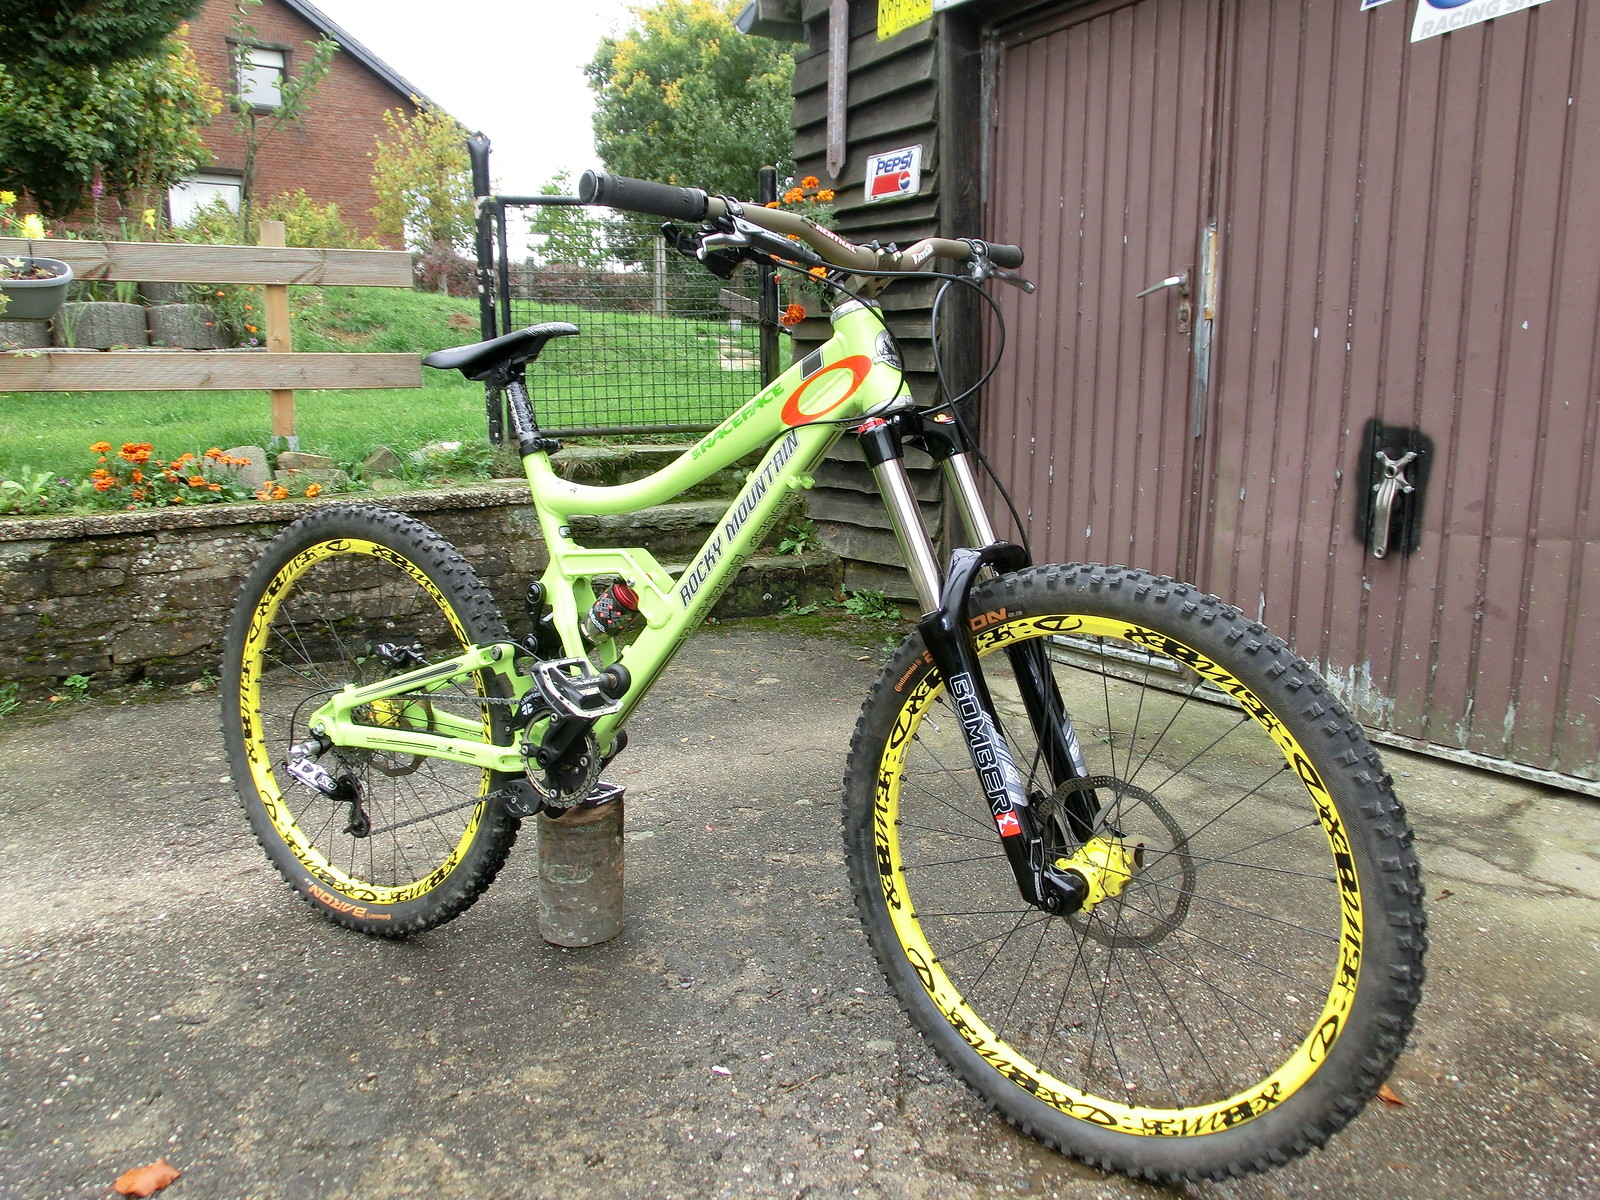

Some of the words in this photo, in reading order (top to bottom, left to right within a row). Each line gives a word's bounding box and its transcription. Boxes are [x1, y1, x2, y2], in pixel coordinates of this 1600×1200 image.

[1419, 2, 1501, 39] RACING
[875, 152, 913, 175] PEPSI
[815, 224, 858, 254] RENTHAL
[678, 535, 723, 609] ROCKY
[724, 429, 799, 544] MOUNTAIN
[949, 671, 1013, 815] BOMBER
[308, 884, 368, 918] BARON
